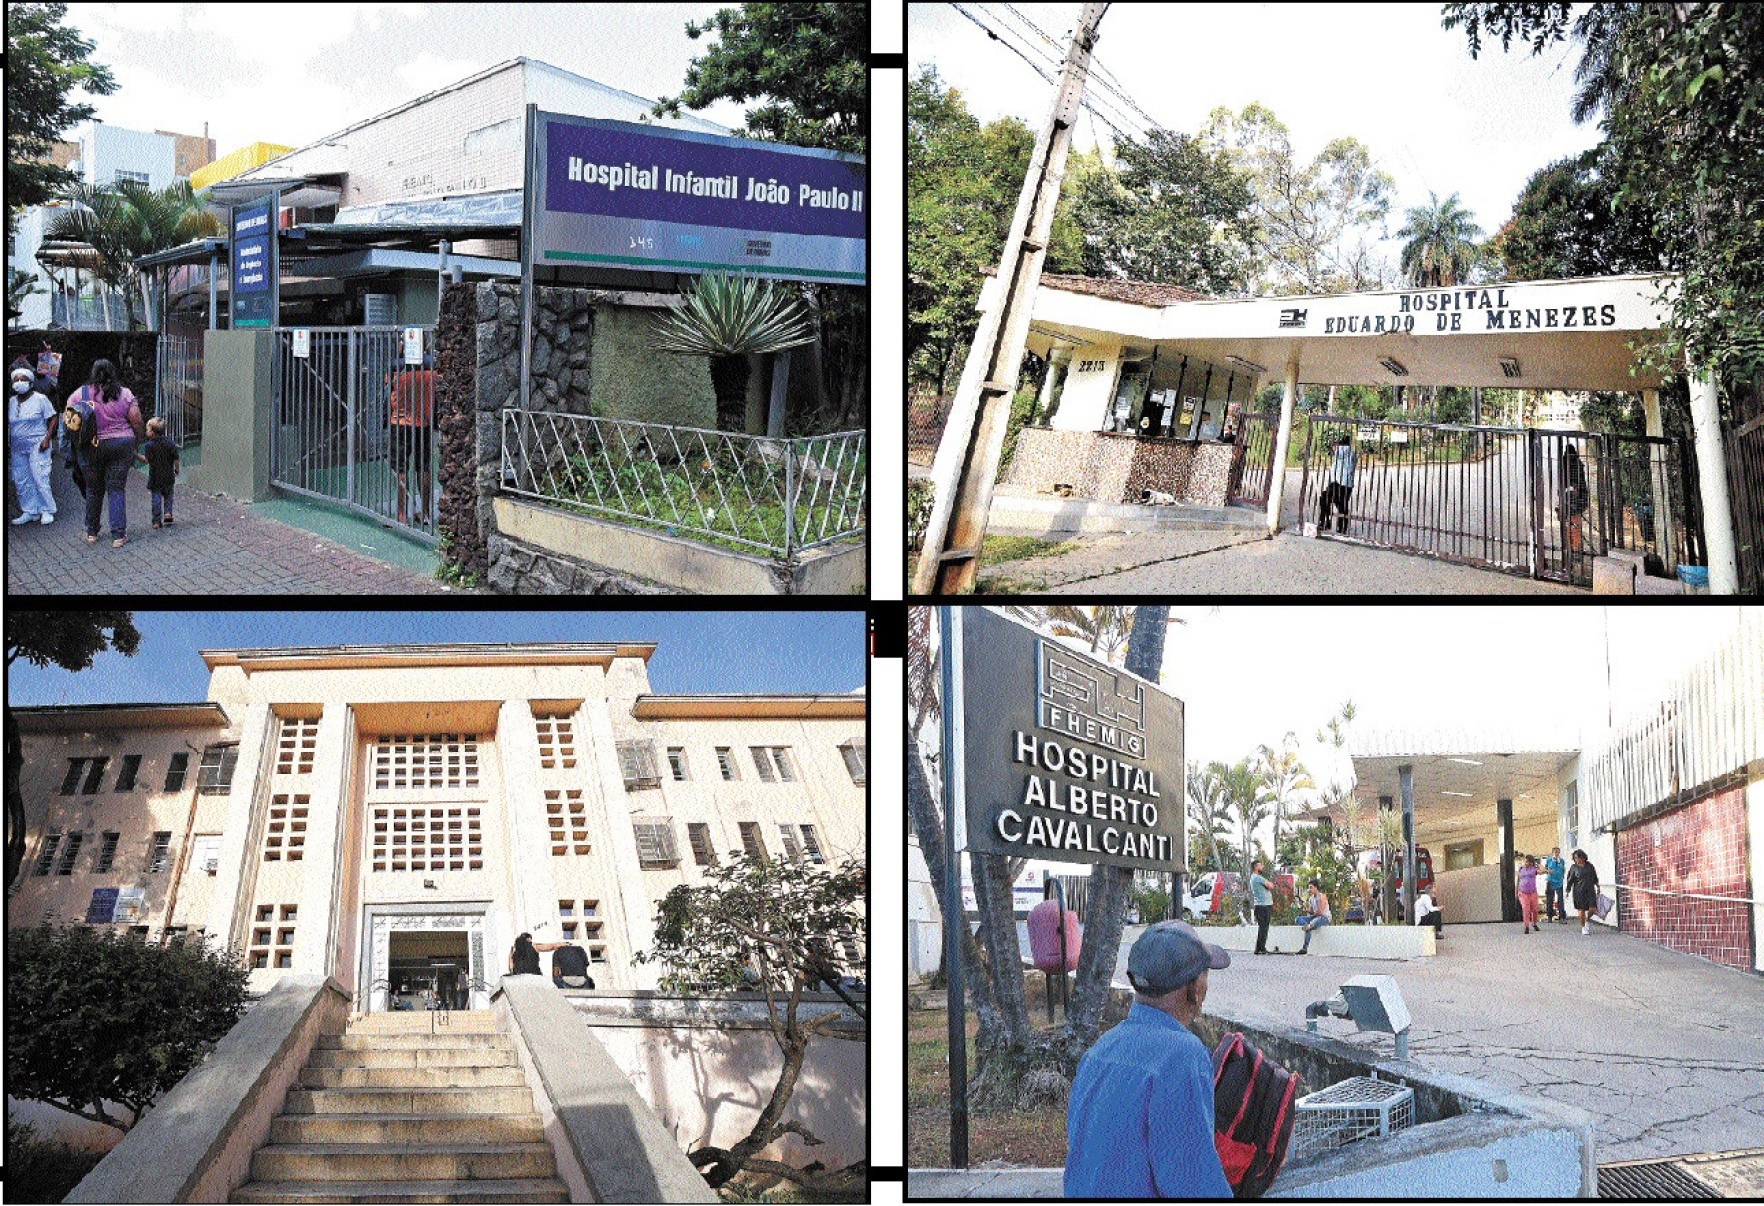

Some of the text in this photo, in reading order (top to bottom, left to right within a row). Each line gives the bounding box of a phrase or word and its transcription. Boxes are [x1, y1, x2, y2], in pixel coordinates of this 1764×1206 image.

[568, 156, 864, 213] Hospital Infantil João Paulo II
[1324, 313, 1415, 334] EDUARDO
[1436, 312, 1462, 332] DE
[1486, 304, 1616, 331] MENEZES
[1399, 289, 1509, 313] HOSPITAL
[1051, 709, 1140, 753] FHEMIG
[1016, 731, 1161, 798] HOSPITAL
[1024, 775, 1159, 828] ALBERTO
[997, 809, 1174, 861] CAVALCANTI
